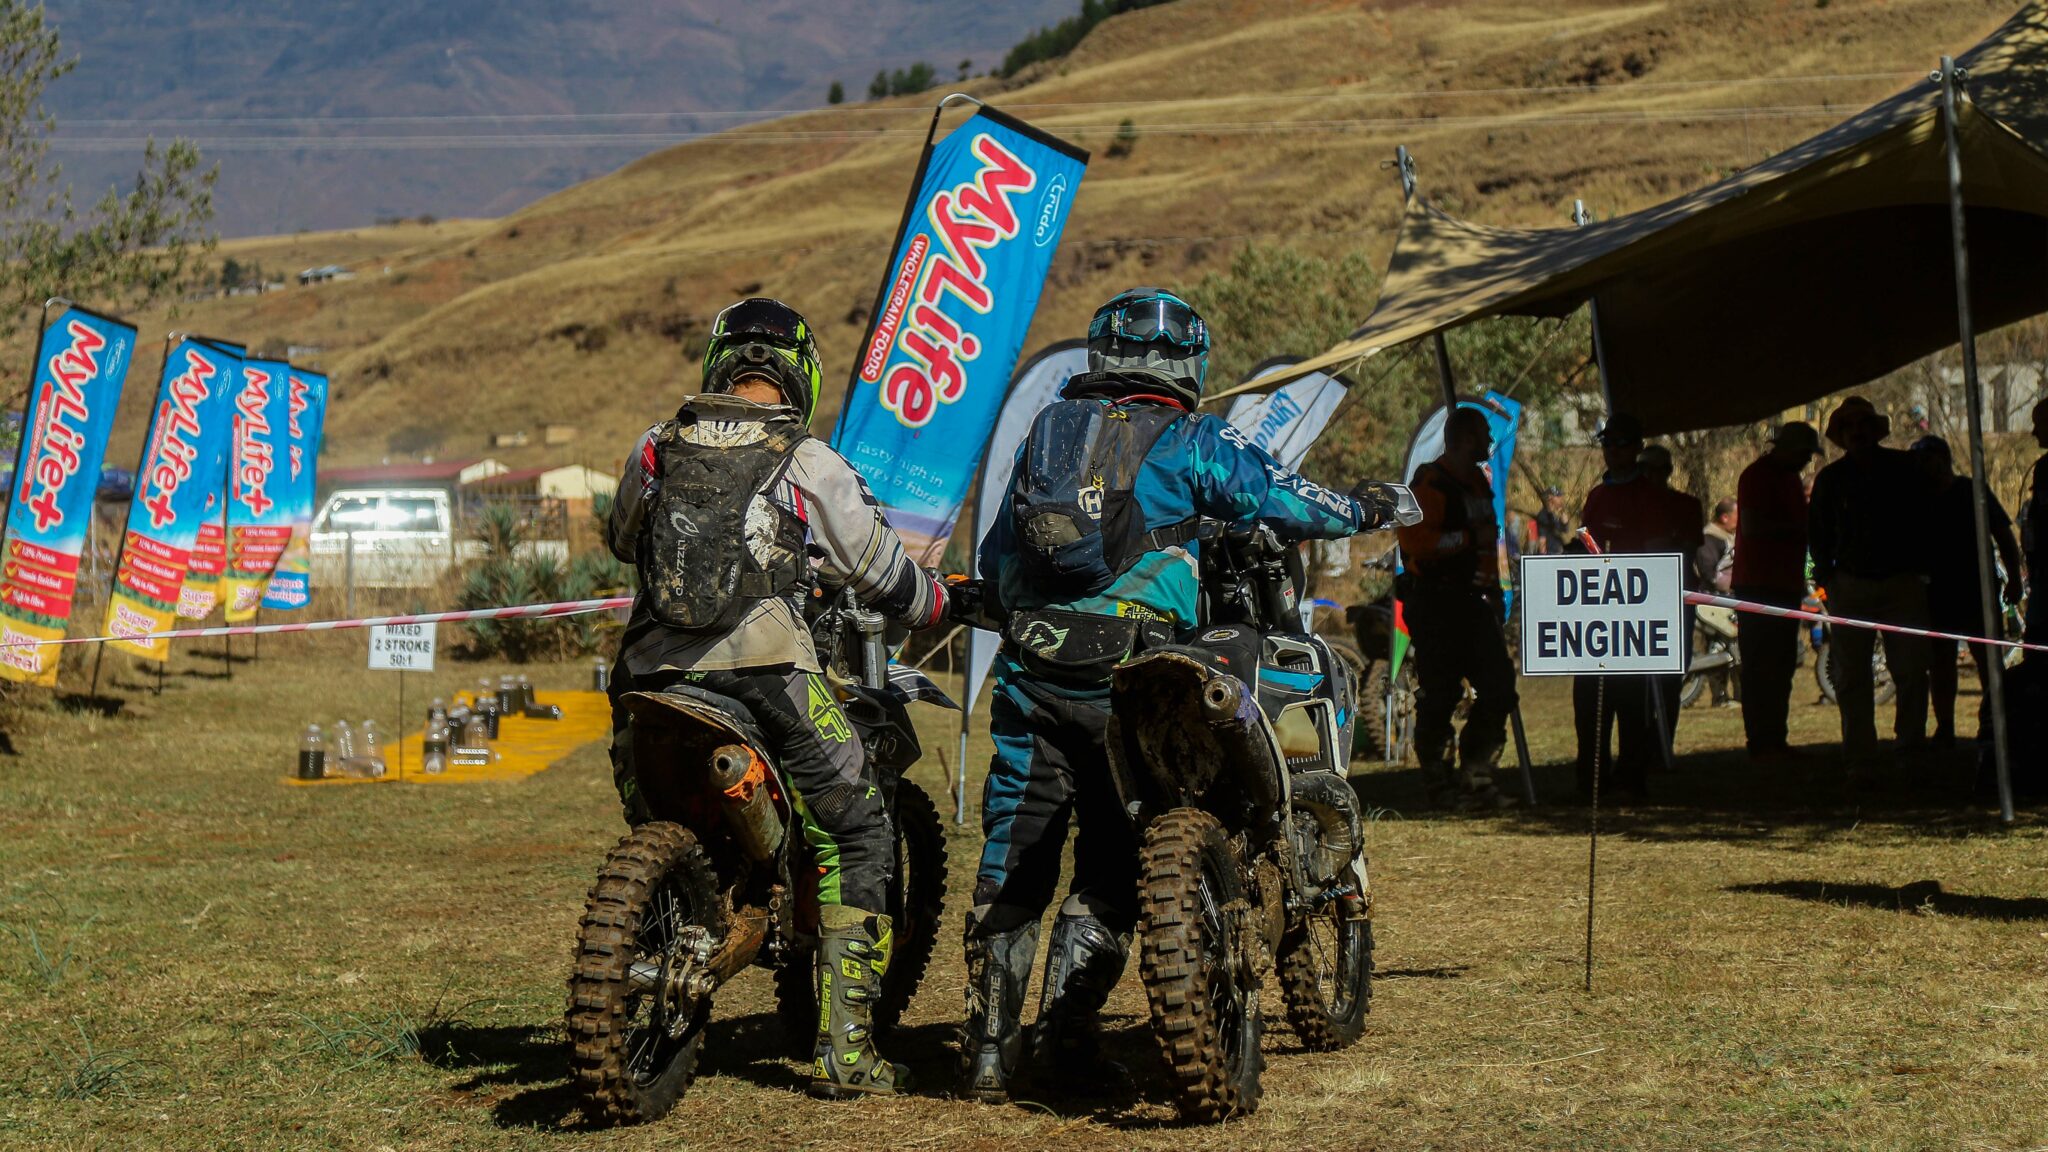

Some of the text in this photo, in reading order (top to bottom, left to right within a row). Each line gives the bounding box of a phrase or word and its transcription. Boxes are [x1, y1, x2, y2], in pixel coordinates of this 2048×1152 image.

[880, 133, 1037, 428] MyLife
[864, 240, 926, 379] WHOLEGRAIN FOODS
[852, 461, 891, 483] nergy
[929, 472, 943, 487] in
[1556, 568, 1649, 606] DEAD
[117, 604, 157, 631] Super
[386, 624, 421, 636] MIXED
[375, 639, 431, 653] 2 STROKE
[1537, 620, 1669, 658] ENGINE
